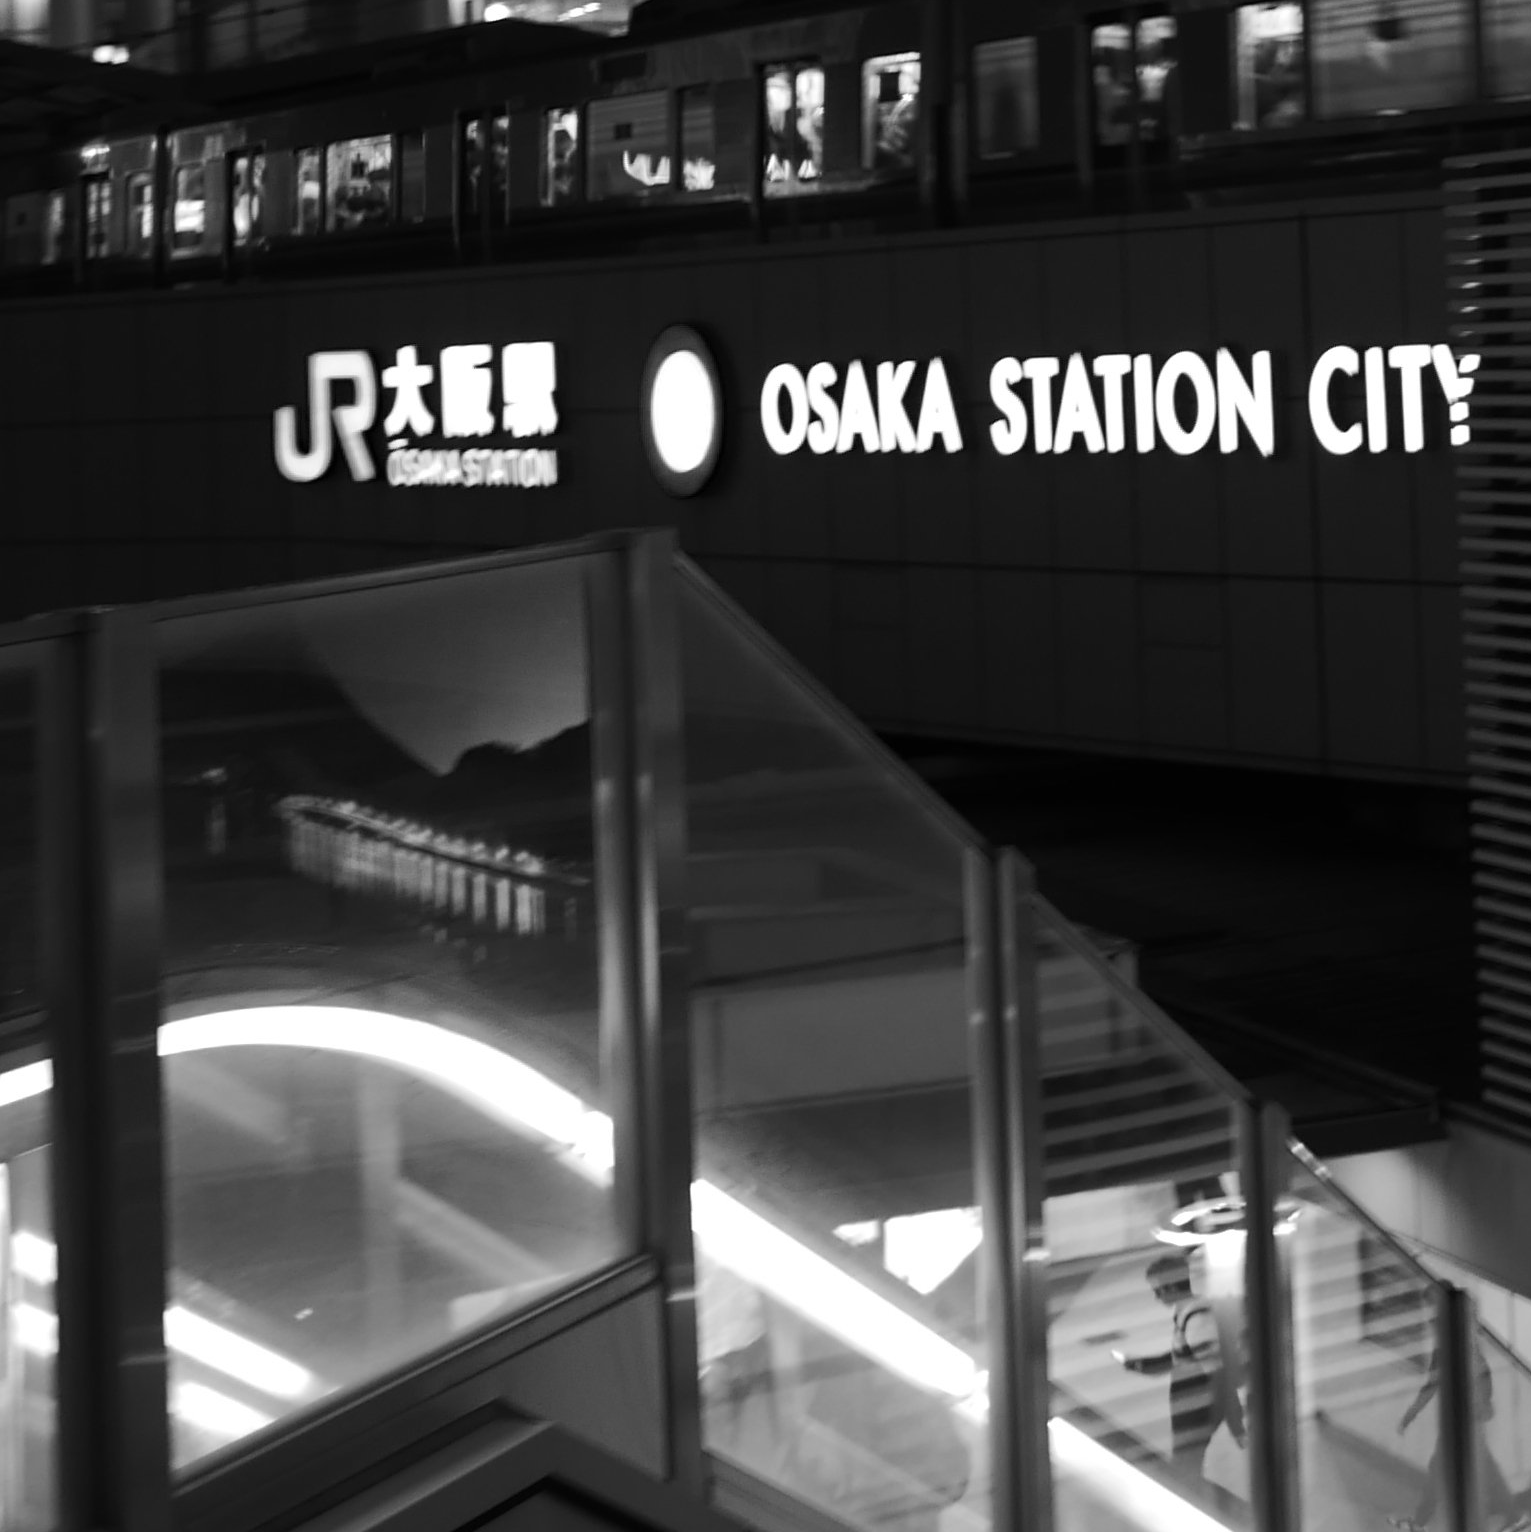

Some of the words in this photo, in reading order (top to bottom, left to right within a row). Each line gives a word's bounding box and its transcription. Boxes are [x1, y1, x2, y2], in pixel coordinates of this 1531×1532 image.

[274, 349, 377, 482] JR
[760, 357, 964, 456] OSAKA
[989, 347, 1275, 458] STATION
[1308, 343, 1481, 455] CITY
